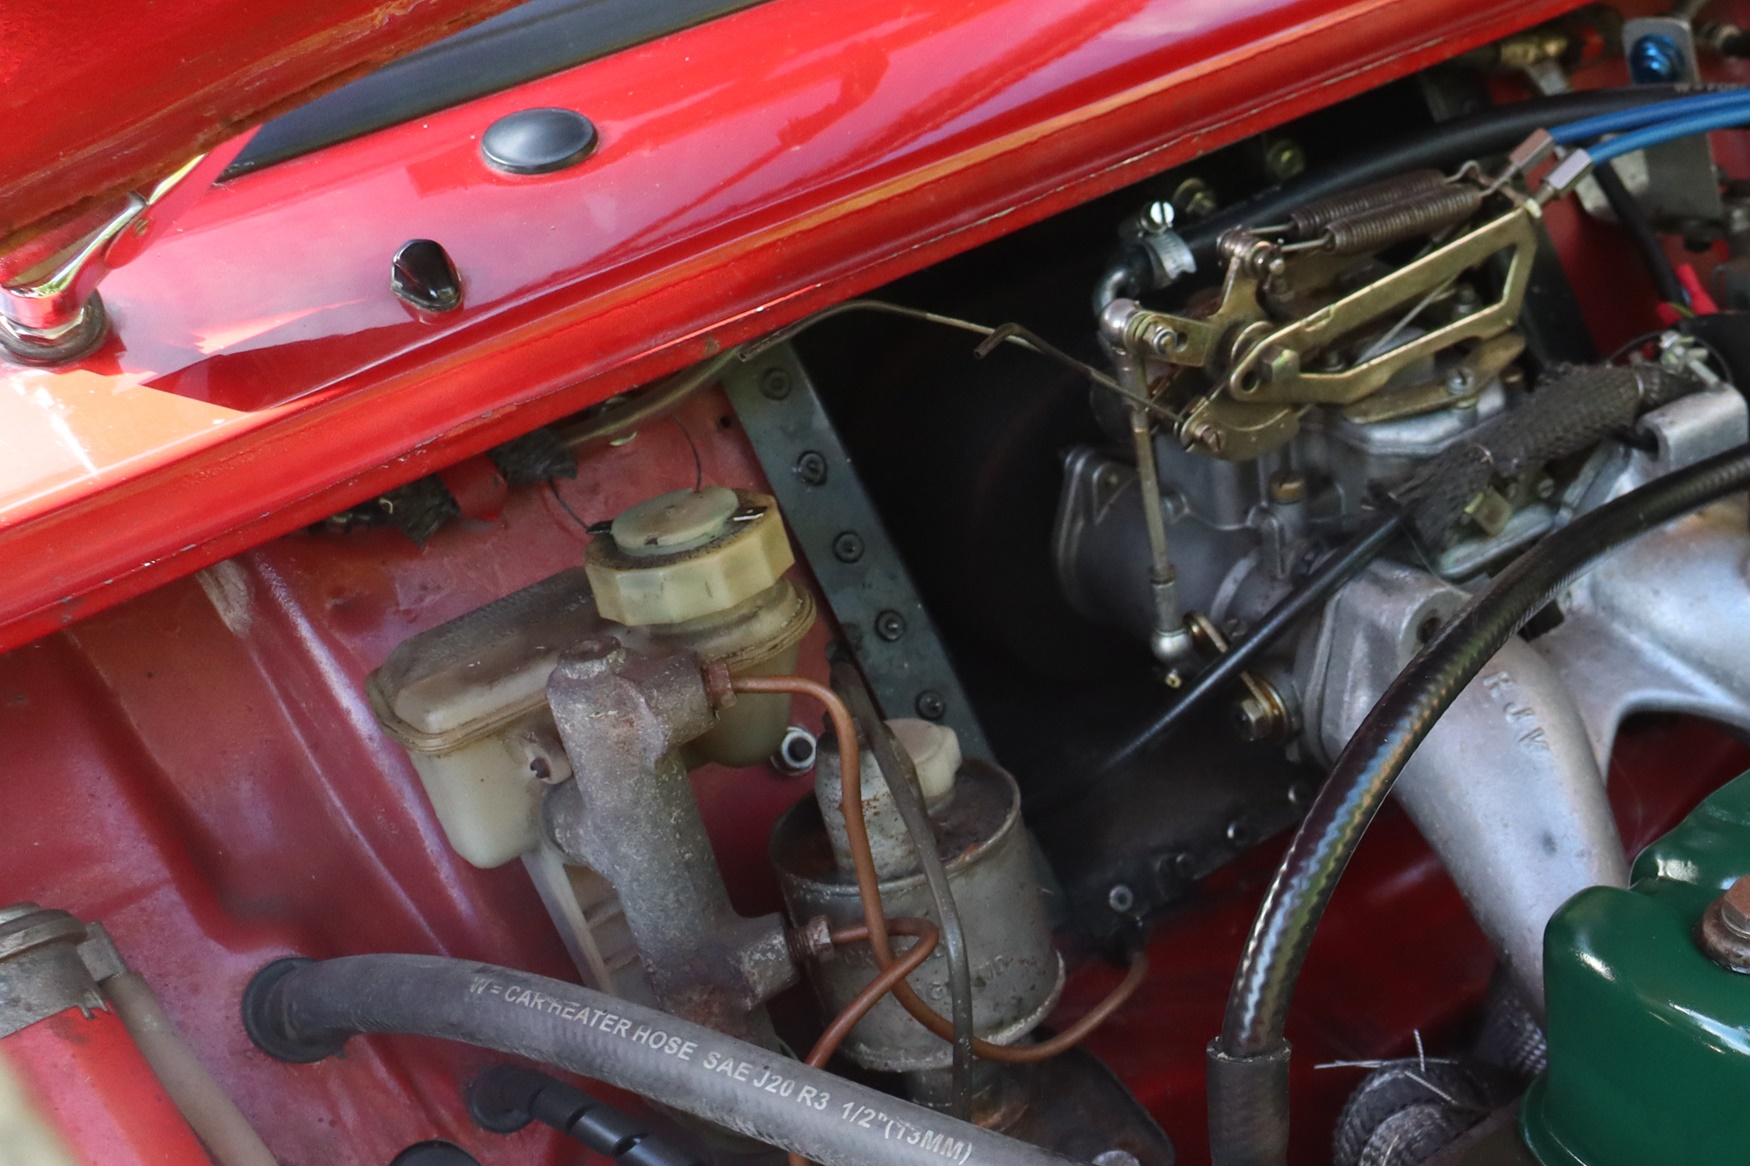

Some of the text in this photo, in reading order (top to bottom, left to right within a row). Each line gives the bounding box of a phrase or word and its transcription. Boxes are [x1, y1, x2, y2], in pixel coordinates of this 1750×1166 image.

[504, 985, 545, 1011] CAR
[546, 999, 633, 1038] HEATER
[632, 1025, 698, 1061] HOSE
[702, 1050, 753, 1082] SAE
[753, 1070, 796, 1098] J20
[797, 1085, 831, 1111] R3
